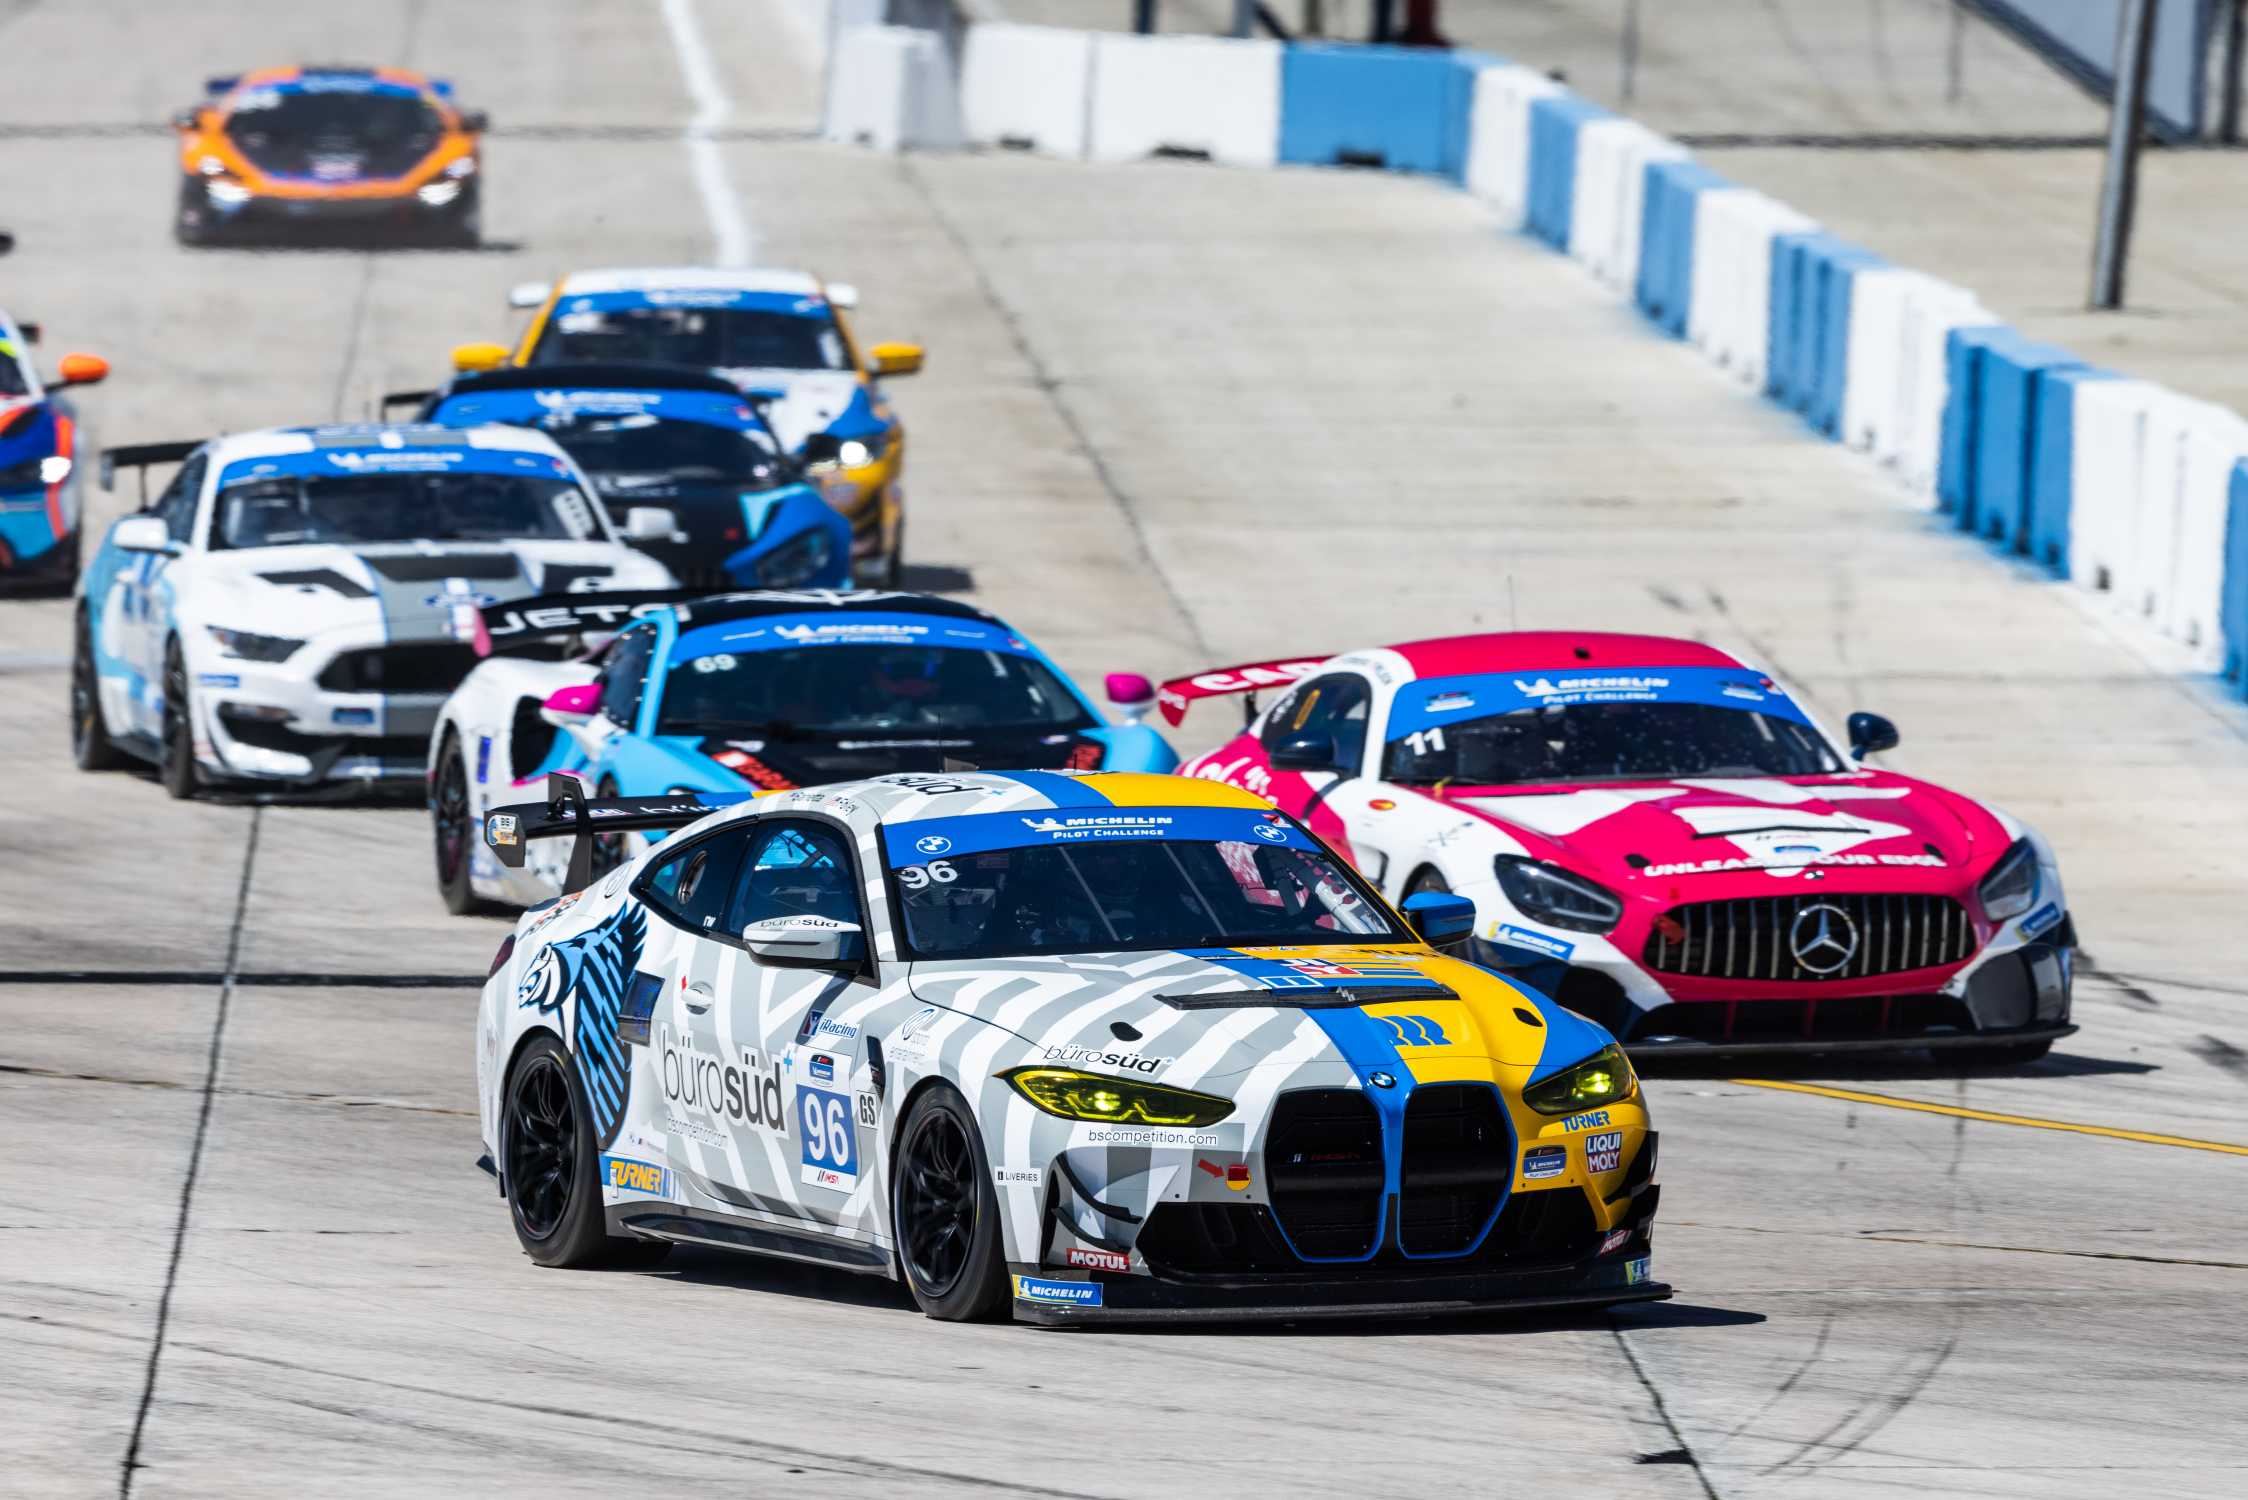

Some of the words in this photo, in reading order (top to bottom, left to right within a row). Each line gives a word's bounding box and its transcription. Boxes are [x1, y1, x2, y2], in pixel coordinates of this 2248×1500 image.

[694, 653, 738, 673] 69
[1558, 678, 1669, 689] MICHELIN
[1404, 727, 1446, 756] 11
[1066, 817, 1173, 826] MICHELIN
[1053, 830, 1089, 839] PILOT
[1093, 829, 1164, 837] CHALLENGE
[899, 861, 958, 889] 96
[819, 1018, 857, 1039] iRacing
[1043, 1045, 1161, 1073] bürosüd
[663, 1029, 785, 1131] bürosüd
[859, 1094, 876, 1126] GS
[804, 1093, 849, 1166] 96
[1561, 1110, 1611, 1132] TURNER
[1088, 1129, 1217, 1145] bscompetition.com
[1587, 1133, 1621, 1153] LIQUI
[1588, 1152, 1619, 1172] MOLY
[610, 1160, 662, 1193] TURNER
[1005, 1171, 1038, 1183] LIVERIES
[1070, 1251, 1128, 1270] MOTUL
[1031, 1285, 1094, 1299] MICHELIN
